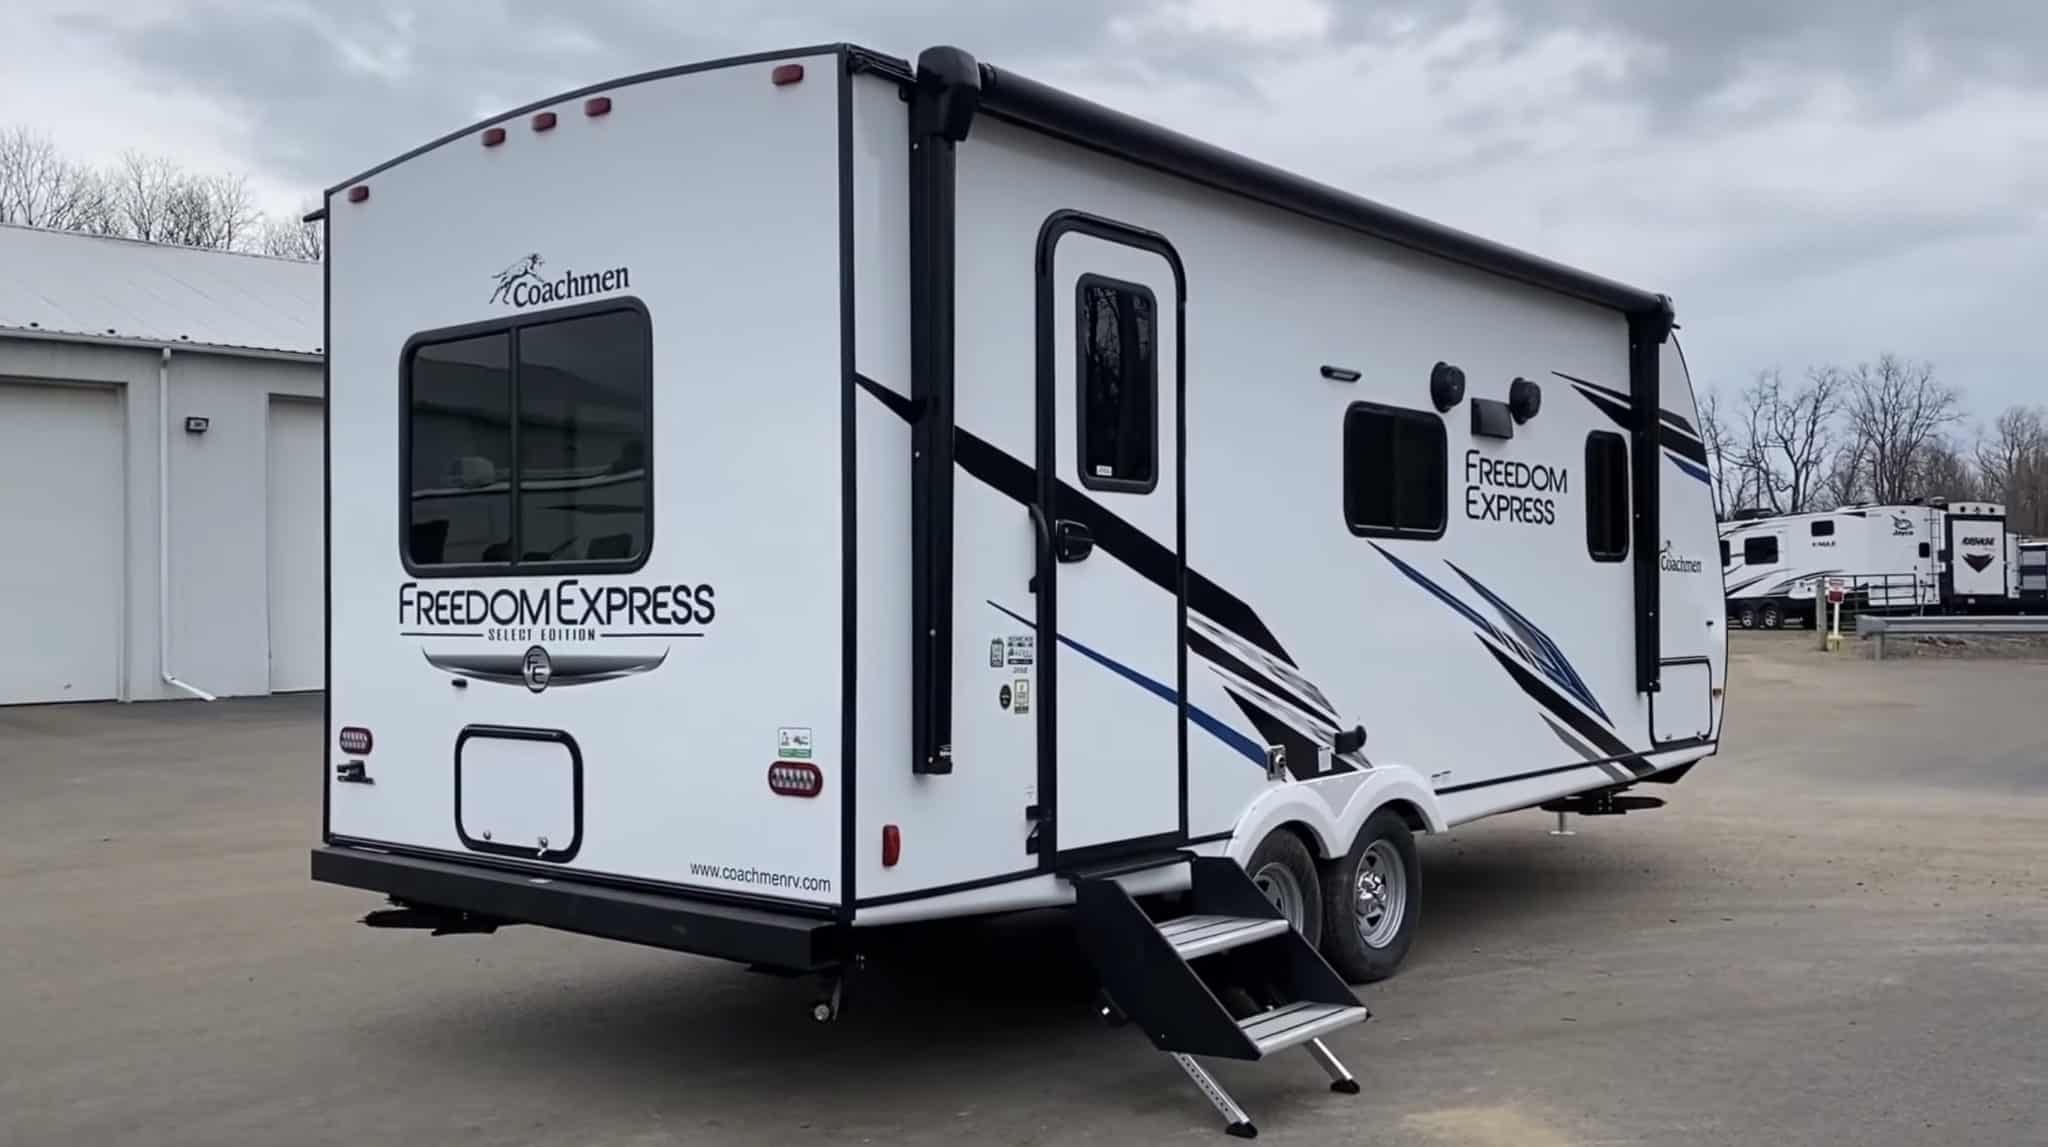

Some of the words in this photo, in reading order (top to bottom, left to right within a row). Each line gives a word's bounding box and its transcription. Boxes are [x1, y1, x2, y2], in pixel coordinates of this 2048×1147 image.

[513, 267, 629, 308] Coachmen
[1466, 450, 1568, 493] FREEDOM
[1466, 486, 1556, 525] EXPRESS
[1661, 555, 1702, 573] Coachmen
[488, 628, 532, 642] SELECT
[541, 628, 596, 642] EDITION
[690, 862, 831, 893] www.coachmenrv.com
